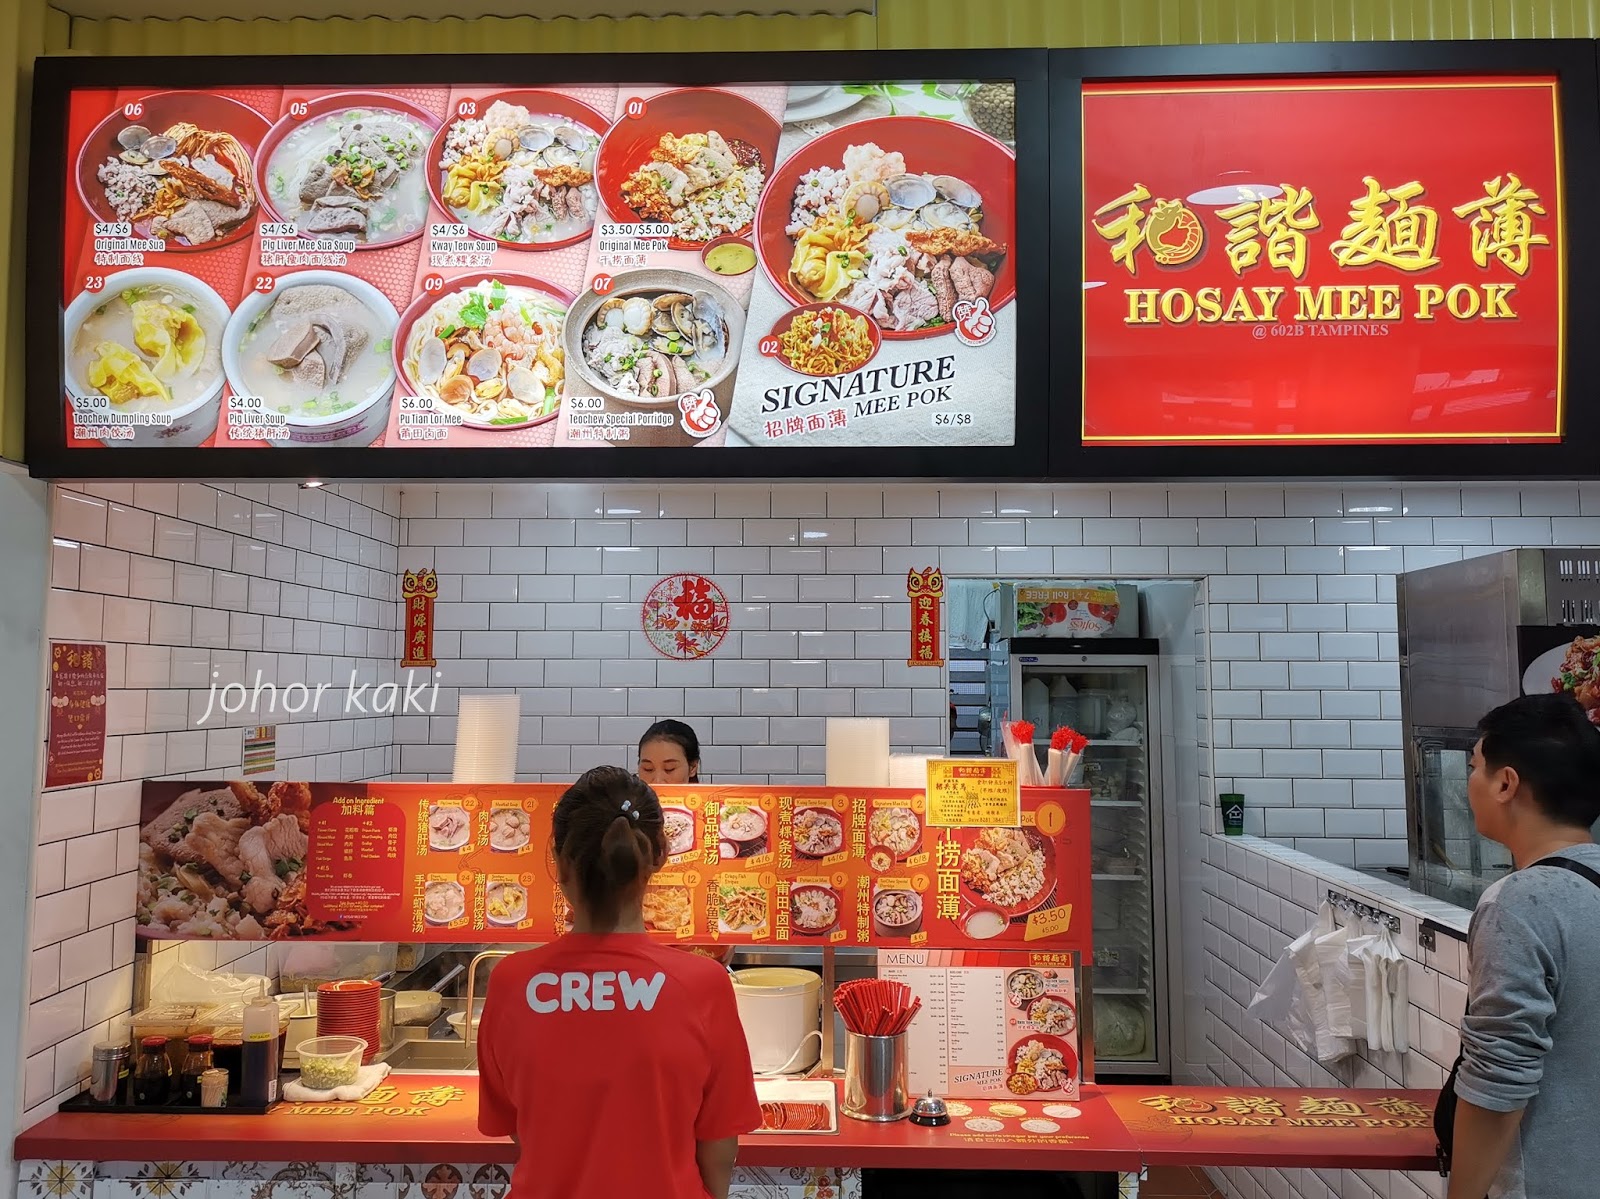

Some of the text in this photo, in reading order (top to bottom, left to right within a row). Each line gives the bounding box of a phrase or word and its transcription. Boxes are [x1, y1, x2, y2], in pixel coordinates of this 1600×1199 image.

[124, 103, 143, 115] 06
[290, 103, 308, 115] 05
[458, 102, 476, 115] 03
[628, 102, 643, 115] 01
[95, 223, 129, 235] $4/$6
[261, 223, 295, 235] $4/$6
[432, 224, 466, 236] $4/$6
[601, 224, 669, 236] $3.50/$5.00
[96, 240, 164, 252] Original Mee Sua
[262, 240, 354, 252] Pig Liver Mee Sua Soup
[432, 240, 496, 252] Kway Teow Soup
[600, 240, 668, 252] Original Mee Pok
[94, 252, 144, 266] 特制面线
[86, 277, 103, 289] 23
[255, 277, 272, 290] 22
[425, 279, 443, 291] 09
[594, 278, 612, 291] 07
[1124, 283, 1517, 323] HOSAY MEE POK
[1252, 324, 1389, 340] @ 602B TAMPINES
[761, 341, 778, 354] 02
[762, 355, 956, 414] SIGNATURE
[76, 398, 107, 409] $5.00
[230, 398, 262, 409] $4.00
[402, 398, 433, 409] $6.00
[571, 398, 602, 409] $6.00
[854, 385, 953, 418] MEE POK
[74, 413, 172, 426] Teochew Dumpling Soup
[230, 413, 286, 425] Pig Liver Soup
[400, 414, 462, 425] Pu Tian Lor Mee
[570, 414, 672, 426] Teochew Special Porridge
[765, 408, 848, 439] 招牌面薄
[935, 413, 971, 426] $6/$8
[229, 427, 290, 440] 传统猪肝汤
[1026, 591, 1048, 599] FREE
[1053, 591, 1069, 599] Roll
[412, 597, 427, 660] 財源廣進
[918, 596, 934, 660] 迎春接福
[355, 797, 384, 806] Ingredient
[466, 799, 475, 807] 22
[765, 798, 771, 806] 4
[838, 799, 844, 807] 3
[916, 800, 923, 808] 2
[340, 804, 376, 816] 加料篇
[1021, 814, 1034, 824] Pok
[416, 799, 429, 856] 传统猪肝汤
[477, 810, 489, 846] 肉丸汤
[703, 801, 720, 865] 御品鲜汤
[778, 796, 793, 869] 现煮粿条汤
[852, 798, 866, 858] 招牌面薄
[687, 874, 696, 883] 12
[765, 876, 771, 884] 11
[836, 875, 843, 884] 9
[917, 878, 924, 886] 7
[473, 873, 486, 931] 潮州肉饺汤
[706, 879, 720, 934] 香脆鱼条
[776, 880, 790, 941] 莆田卤面
[1032, 908, 1066, 925] $3.50
[886, 954, 924, 965] MENU
[526, 970, 666, 1013] CREW
[954, 1069, 1004, 1084] SIGNATURE
[284, 1106, 432, 1115] MEE POK
[1173, 1115, 1428, 1128] HOSAY MEE POK
